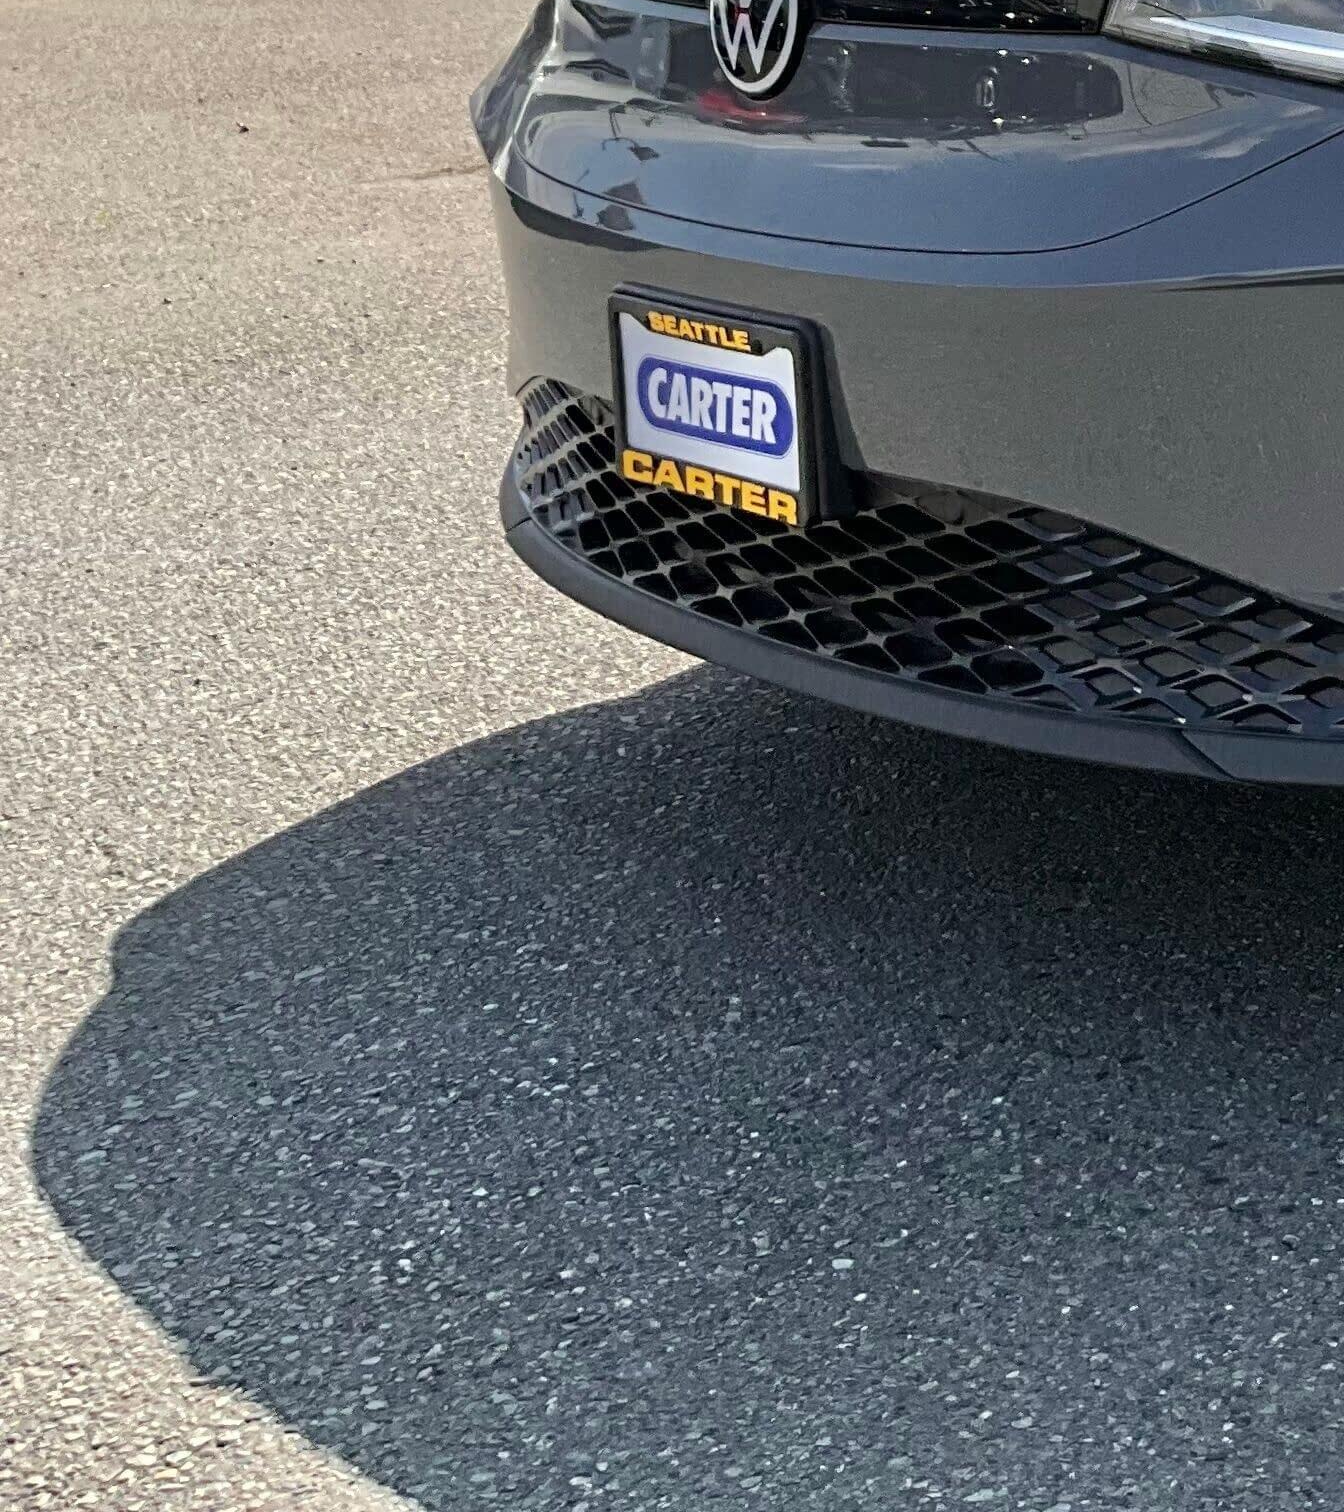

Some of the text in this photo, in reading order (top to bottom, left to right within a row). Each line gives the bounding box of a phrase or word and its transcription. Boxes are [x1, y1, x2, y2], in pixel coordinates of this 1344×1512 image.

[647, 310, 751, 352] SEATTLE
[648, 366, 777, 444] CARTER
[622, 449, 798, 526] CARTER
